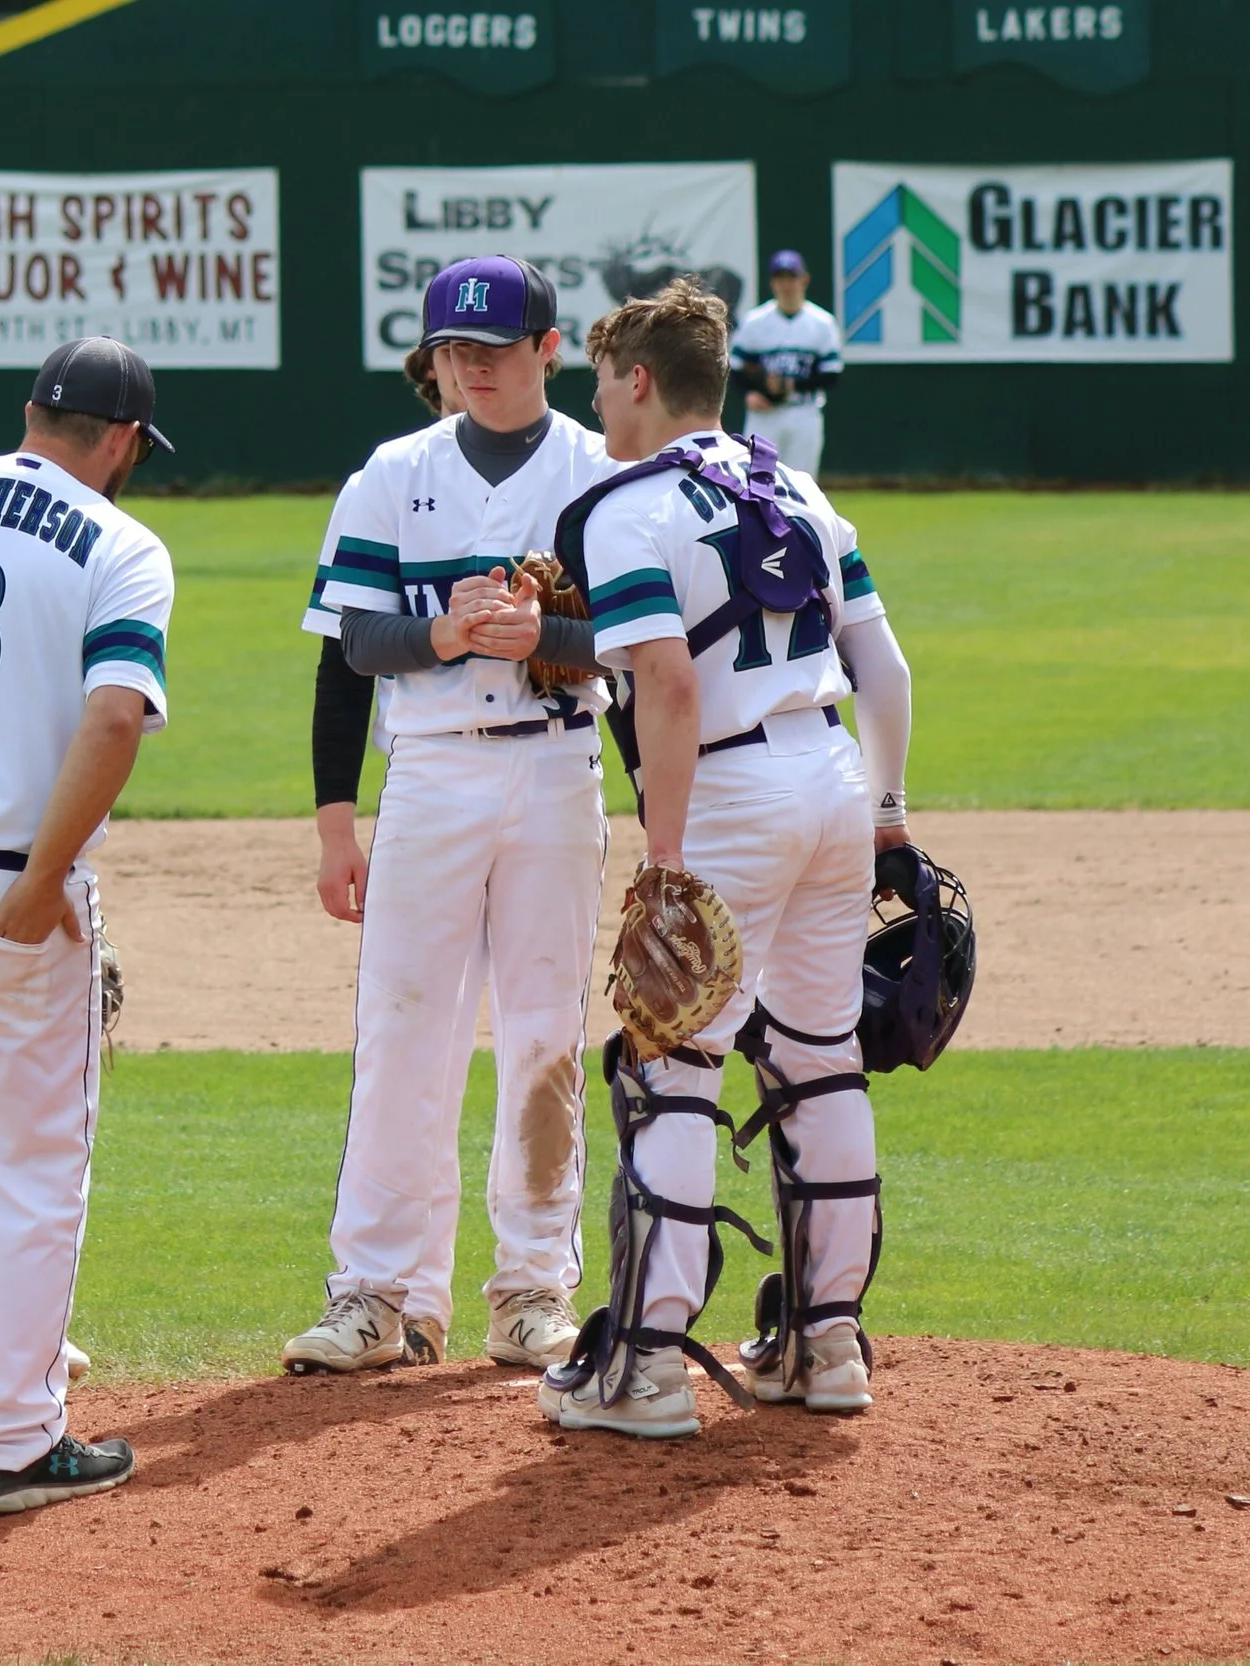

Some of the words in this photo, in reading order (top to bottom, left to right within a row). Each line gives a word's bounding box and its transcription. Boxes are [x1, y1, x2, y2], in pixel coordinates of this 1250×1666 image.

[377, 13, 537, 49] LOGGERS
[693, 7, 806, 43] TWINS
[976, 4, 1123, 41] LAKERS
[62, 192, 252, 241] SPIRITS
[404, 189, 555, 230] LIBBY
[969, 181, 1224, 254] GLACIER
[153, 252, 277, 301] WINE
[1012, 269, 1182, 338] BANK
[219, 315, 255, 342] MT
[52, 384, 63, 400] 3
